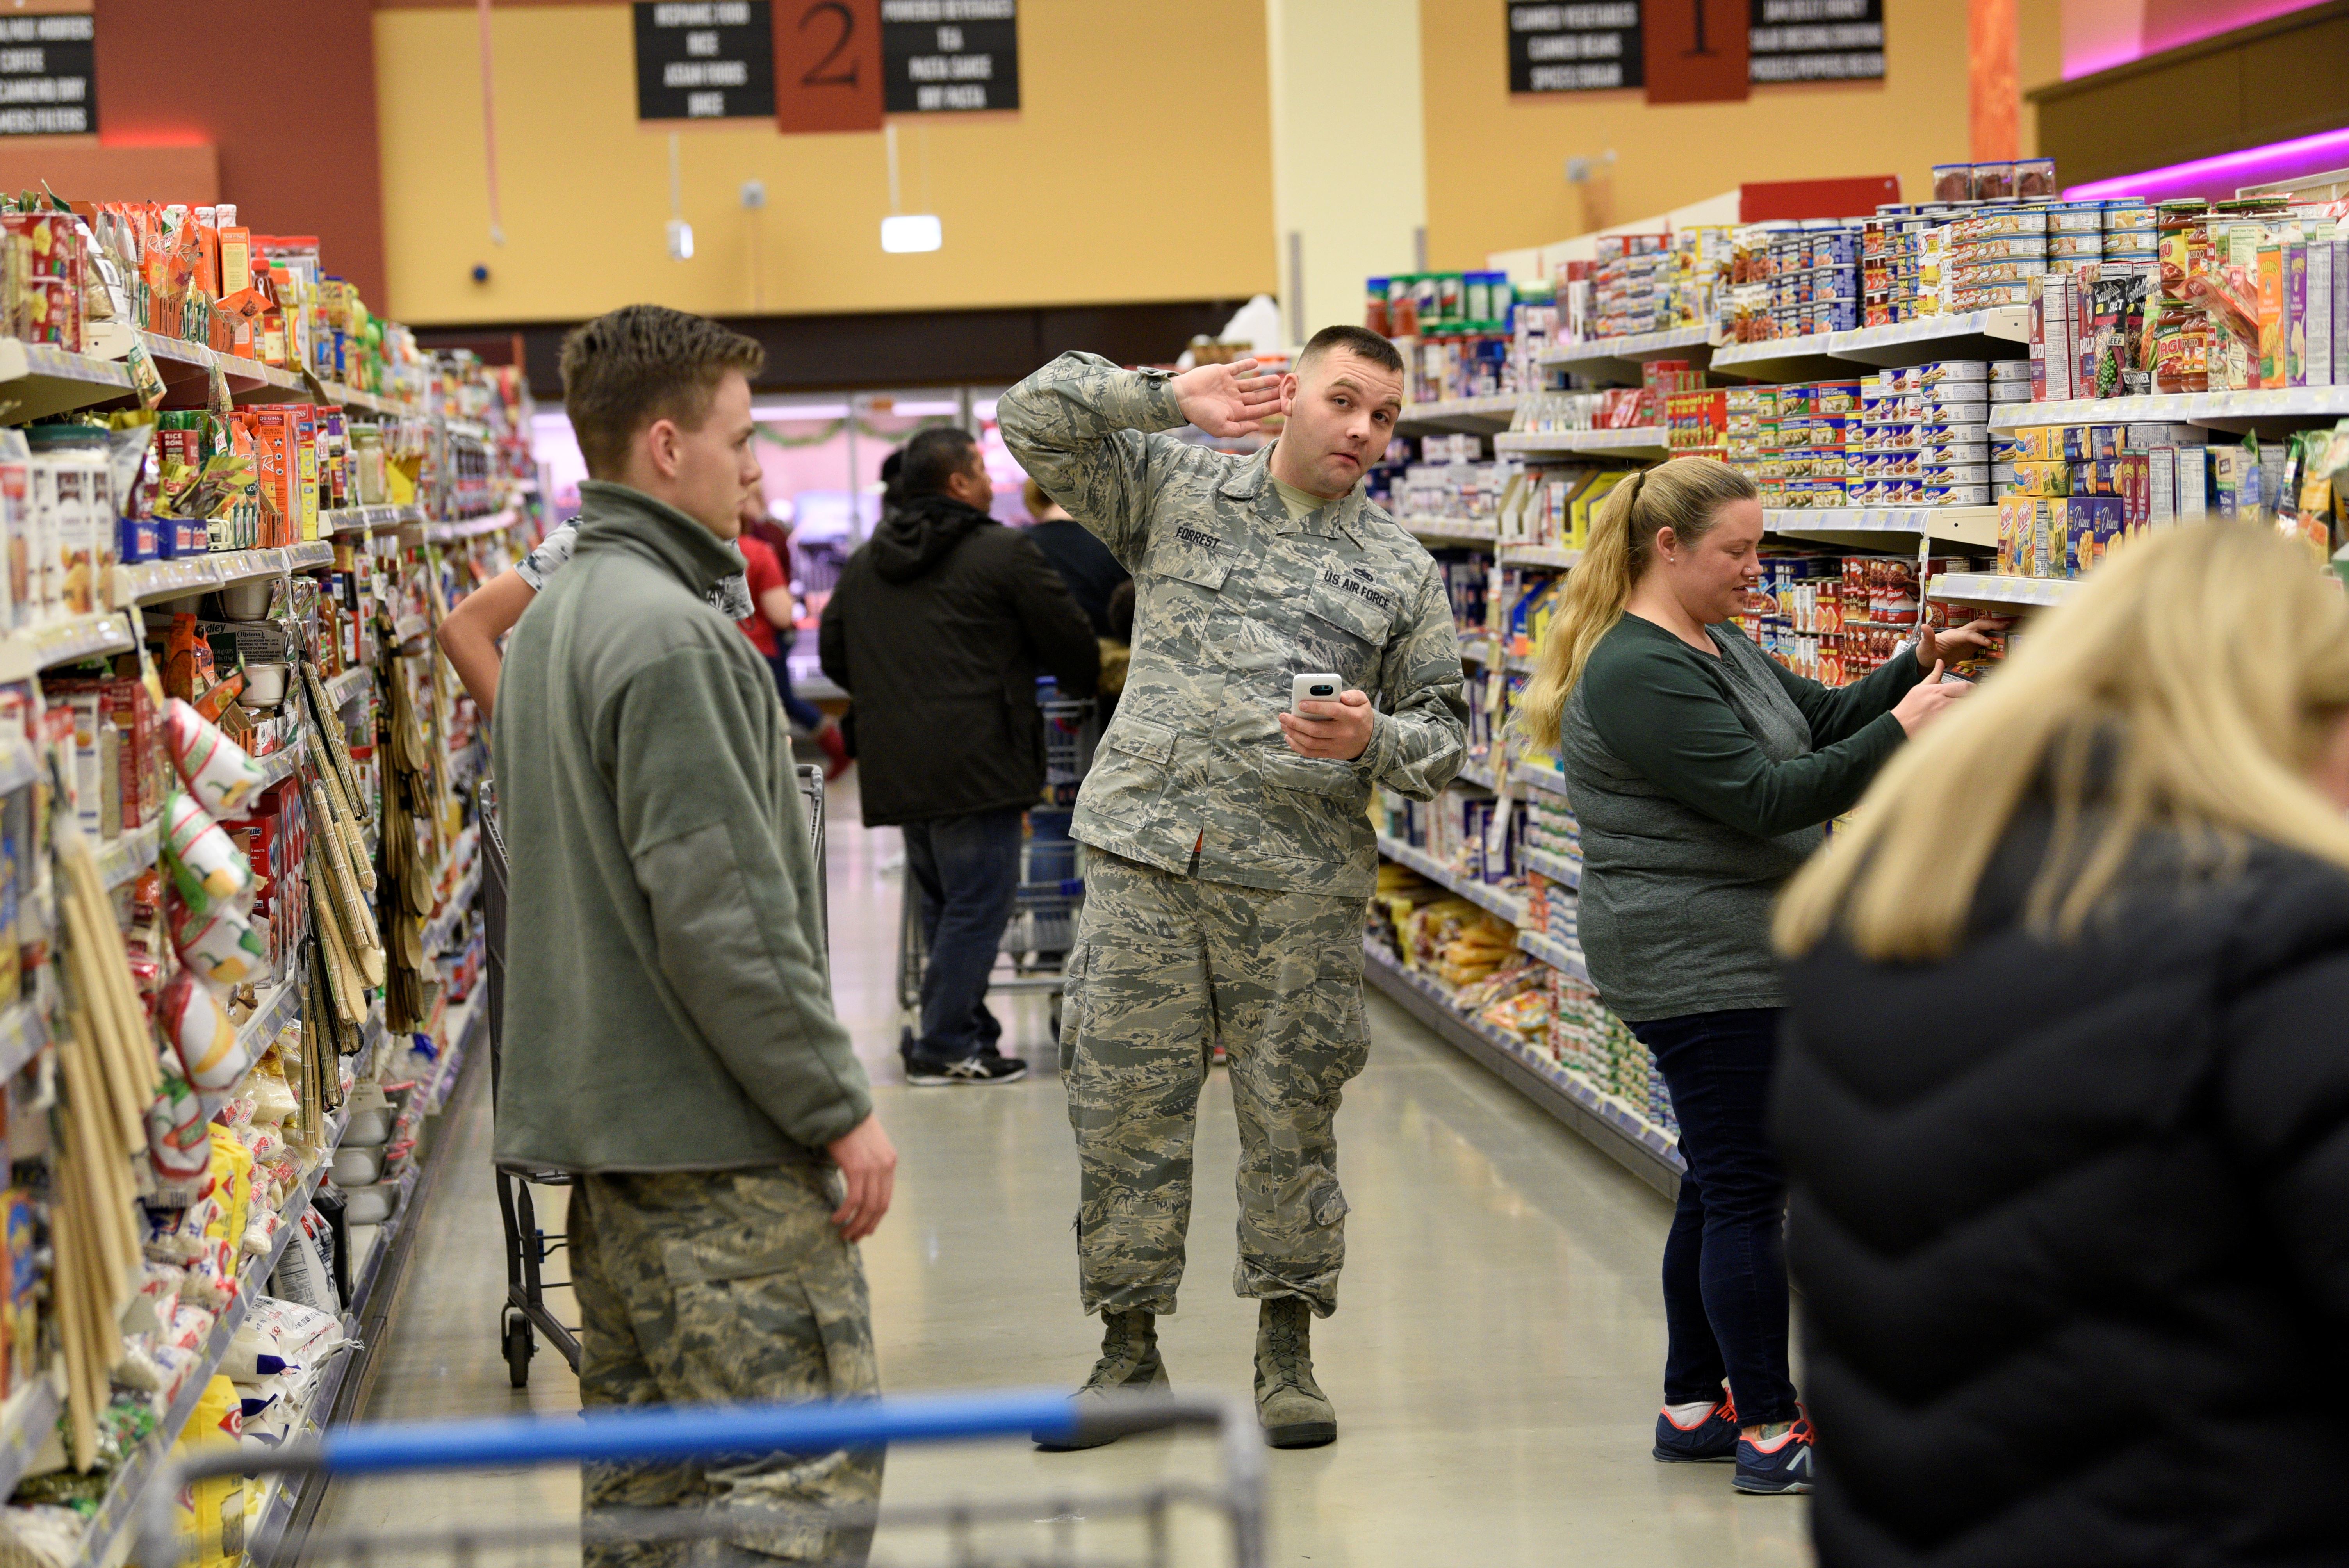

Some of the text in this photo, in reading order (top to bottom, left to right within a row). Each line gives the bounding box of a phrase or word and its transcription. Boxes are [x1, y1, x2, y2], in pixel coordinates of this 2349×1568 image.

[797, 2, 858, 88] 2
[2131, 372, 2150, 384] DINNER
[2074, 505, 2090, 532] Deluxe
[2101, 506, 2119, 533] Deluxe
[1174, 526, 1221, 549] FORREST
[1342, 578, 1360, 594] AIR
[1361, 586, 1390, 610] FORCE
